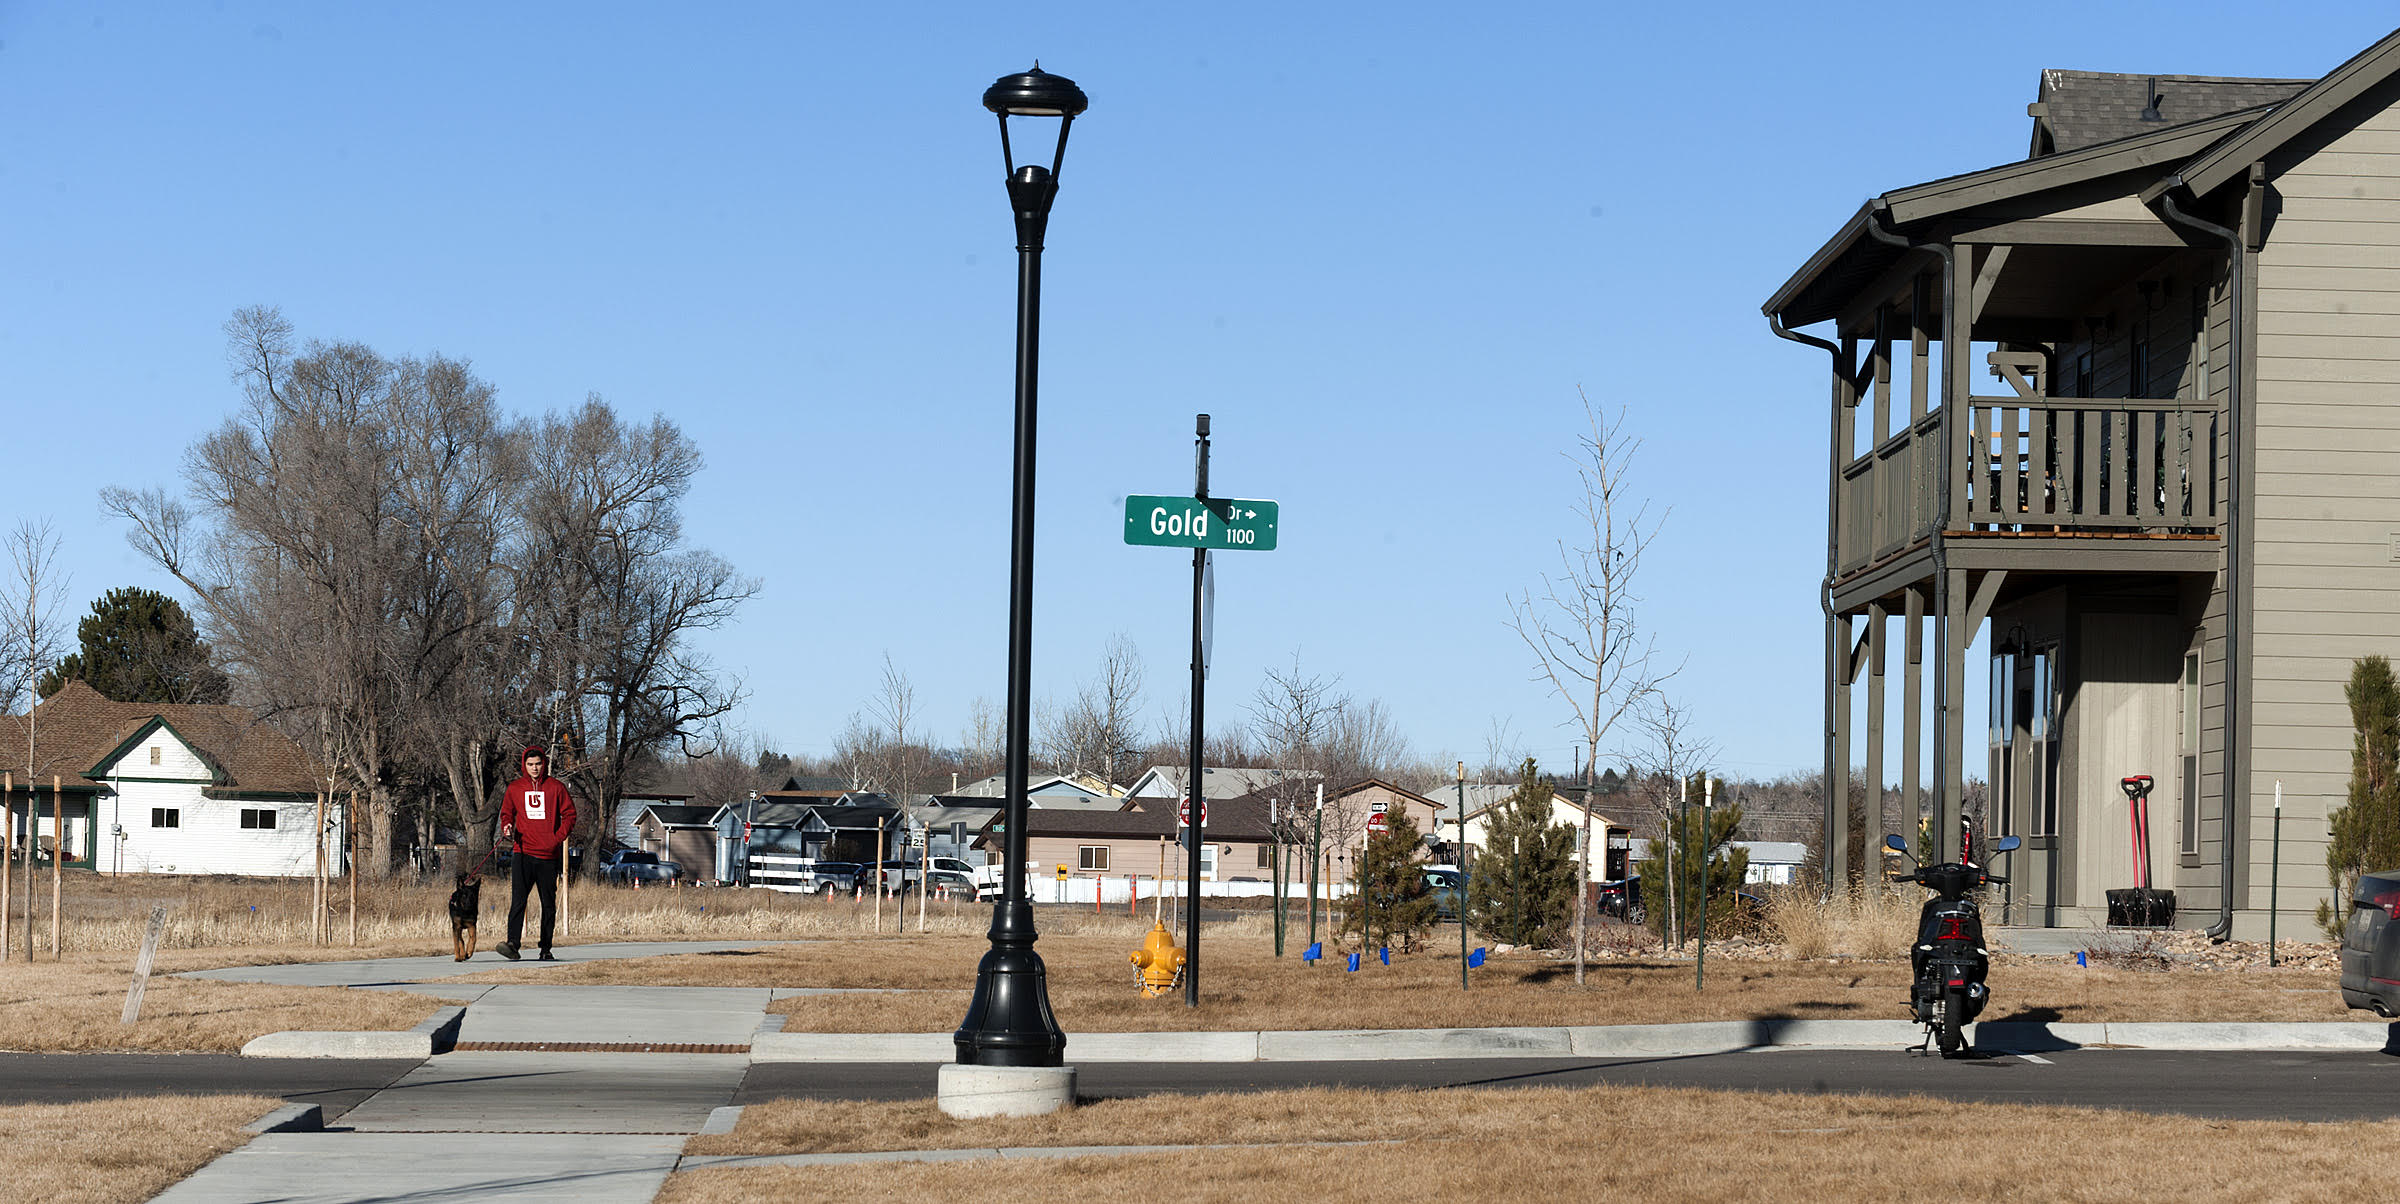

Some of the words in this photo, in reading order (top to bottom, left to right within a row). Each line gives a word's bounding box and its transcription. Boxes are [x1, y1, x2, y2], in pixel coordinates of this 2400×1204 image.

[1151, 507, 1208, 537] Gold
[1227, 505, 1242, 520] Dr
[1226, 528, 1255, 544] 1100
